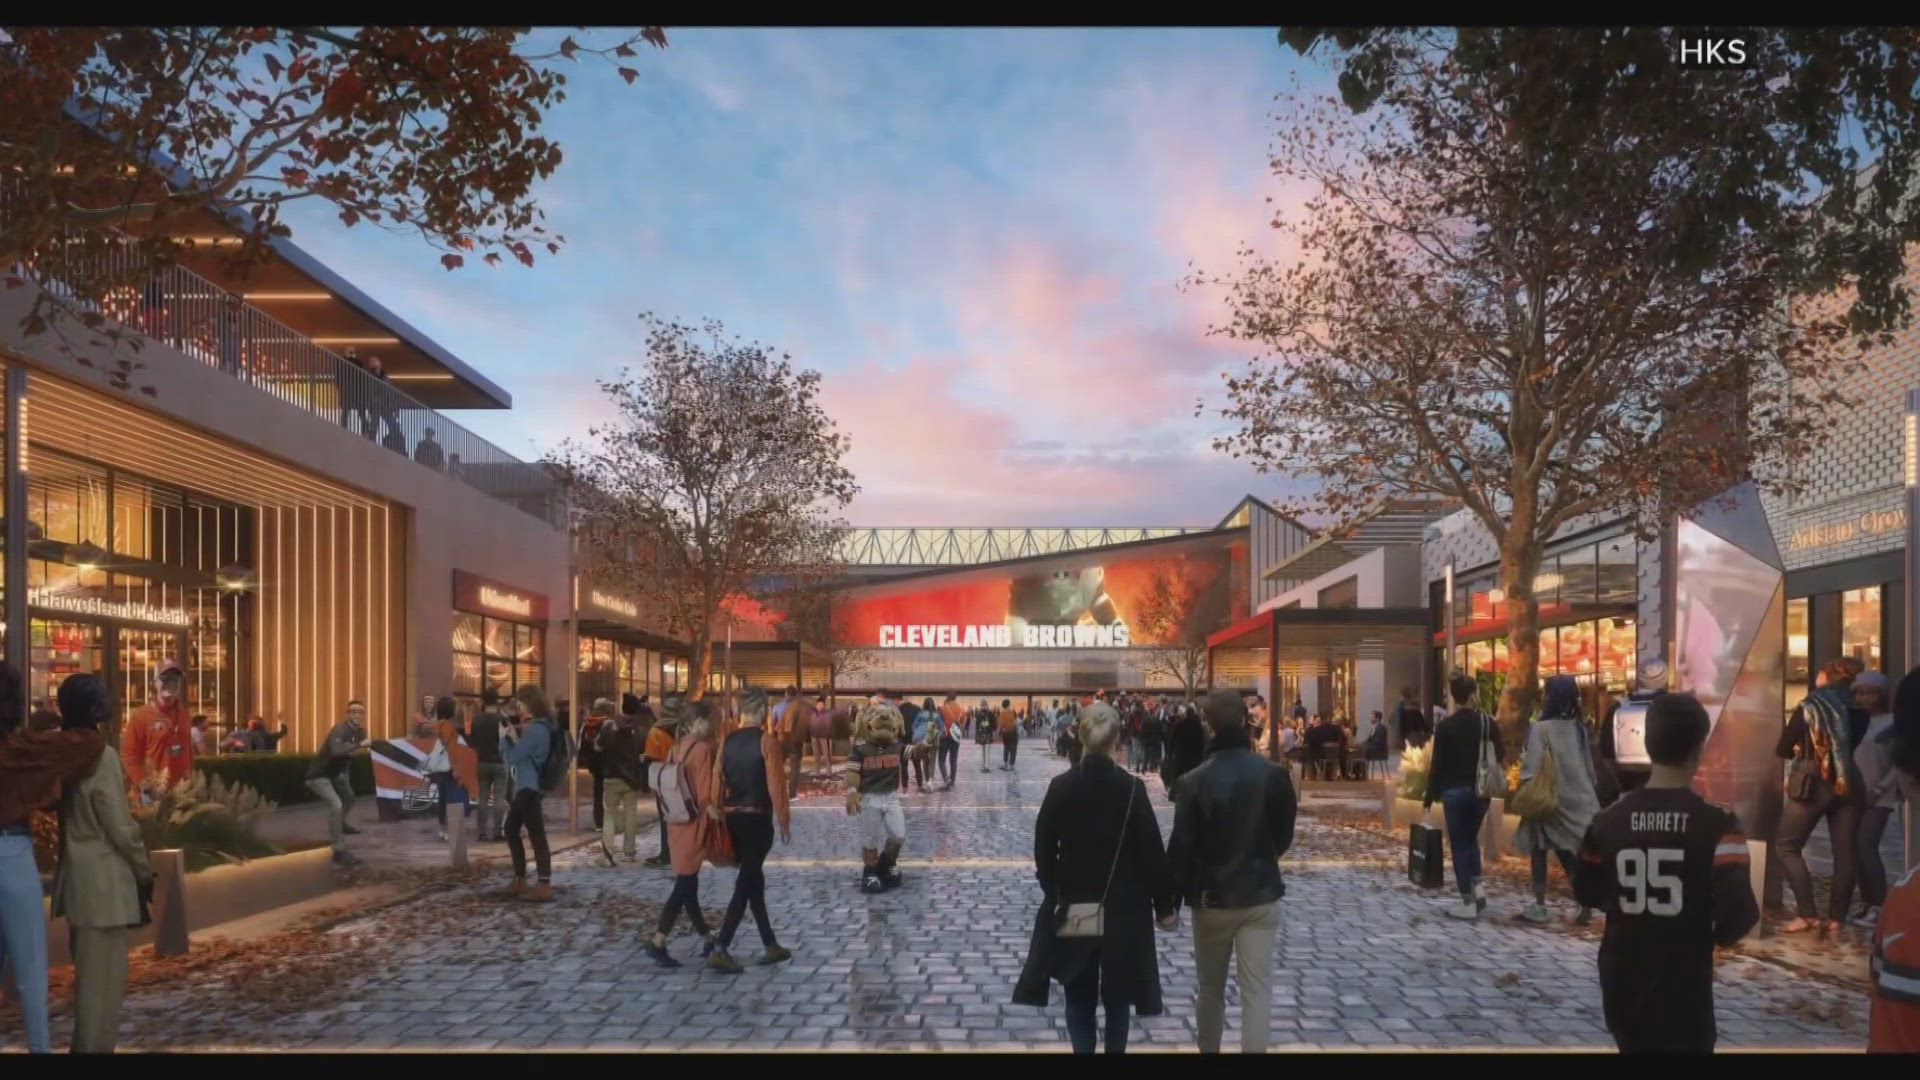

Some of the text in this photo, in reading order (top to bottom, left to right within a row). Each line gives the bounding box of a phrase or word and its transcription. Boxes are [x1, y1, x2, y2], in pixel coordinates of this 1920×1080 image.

[879, 624, 1130, 648] CLEVELAND BROWNS
[1631, 811, 1690, 833] GARRETT
[1616, 848, 1685, 916] 95
